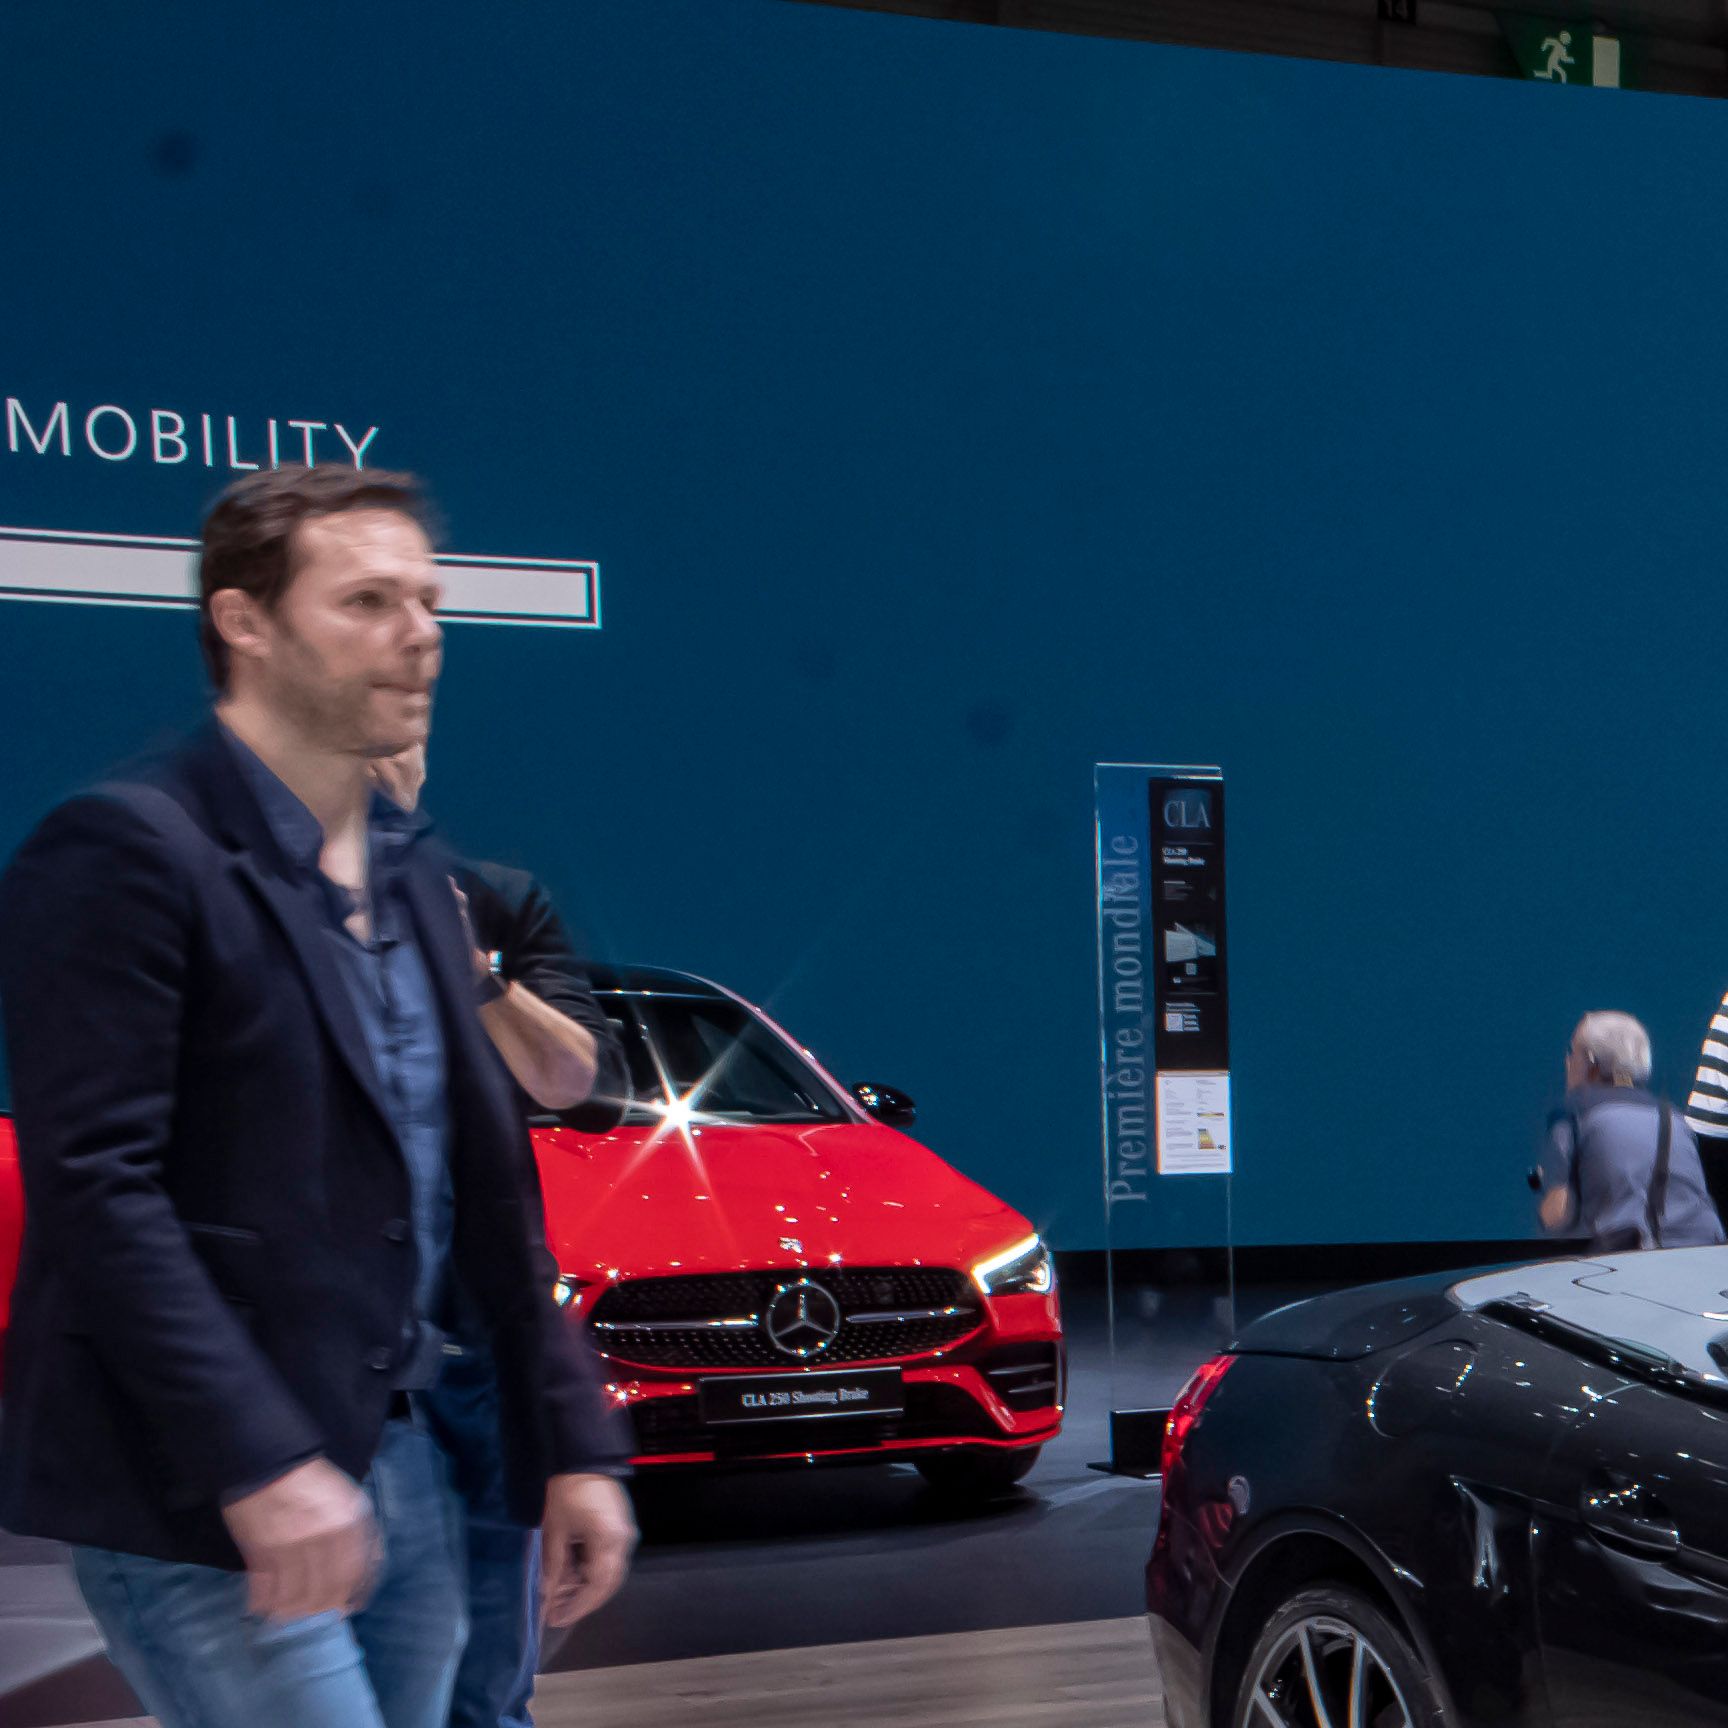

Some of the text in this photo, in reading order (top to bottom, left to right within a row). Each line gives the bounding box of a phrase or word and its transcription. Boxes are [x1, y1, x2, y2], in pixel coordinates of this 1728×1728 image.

[5, 397, 379, 471] MOBILITY
[1163, 799, 1211, 829] CLA
[1102, 835, 1147, 1202] Première mondiale
[742, 1393, 767, 1407] CLA
